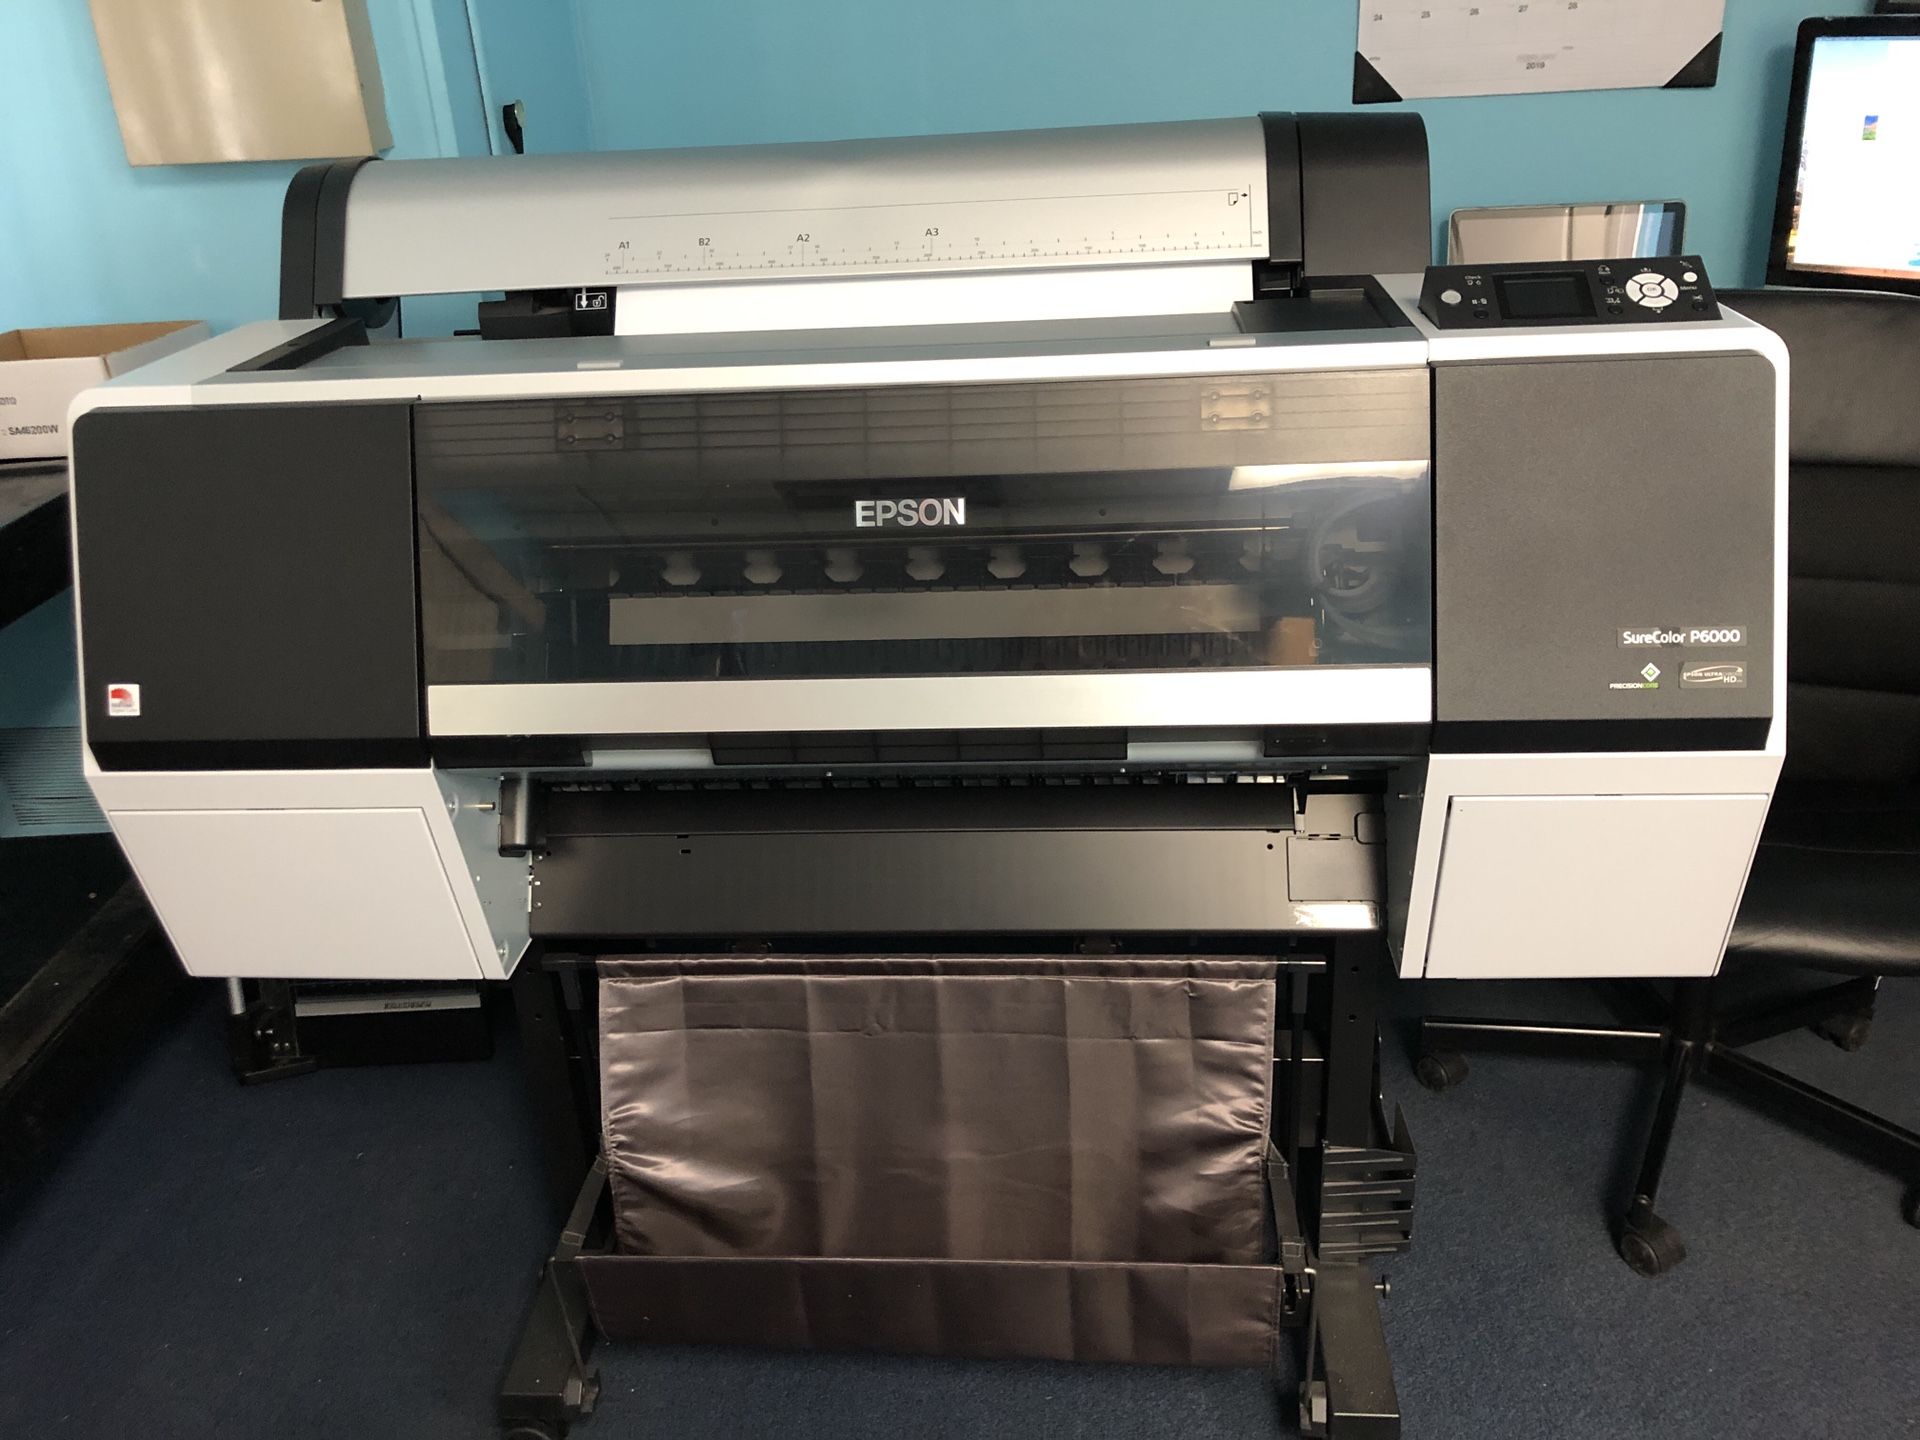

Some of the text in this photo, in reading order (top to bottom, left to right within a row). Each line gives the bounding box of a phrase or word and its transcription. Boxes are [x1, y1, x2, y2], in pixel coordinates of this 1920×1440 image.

[1518, 4, 1528, 13] 27
[1526, 61, 1545, 70] 2019
[925, 228, 939, 237] A3
[698, 237, 711, 246] B2
[796, 233, 810, 242] A2
[618, 241, 630, 249] A1
[855, 497, 966, 528] EPSON
[1622, 629, 1741, 645] SureColor P6000
